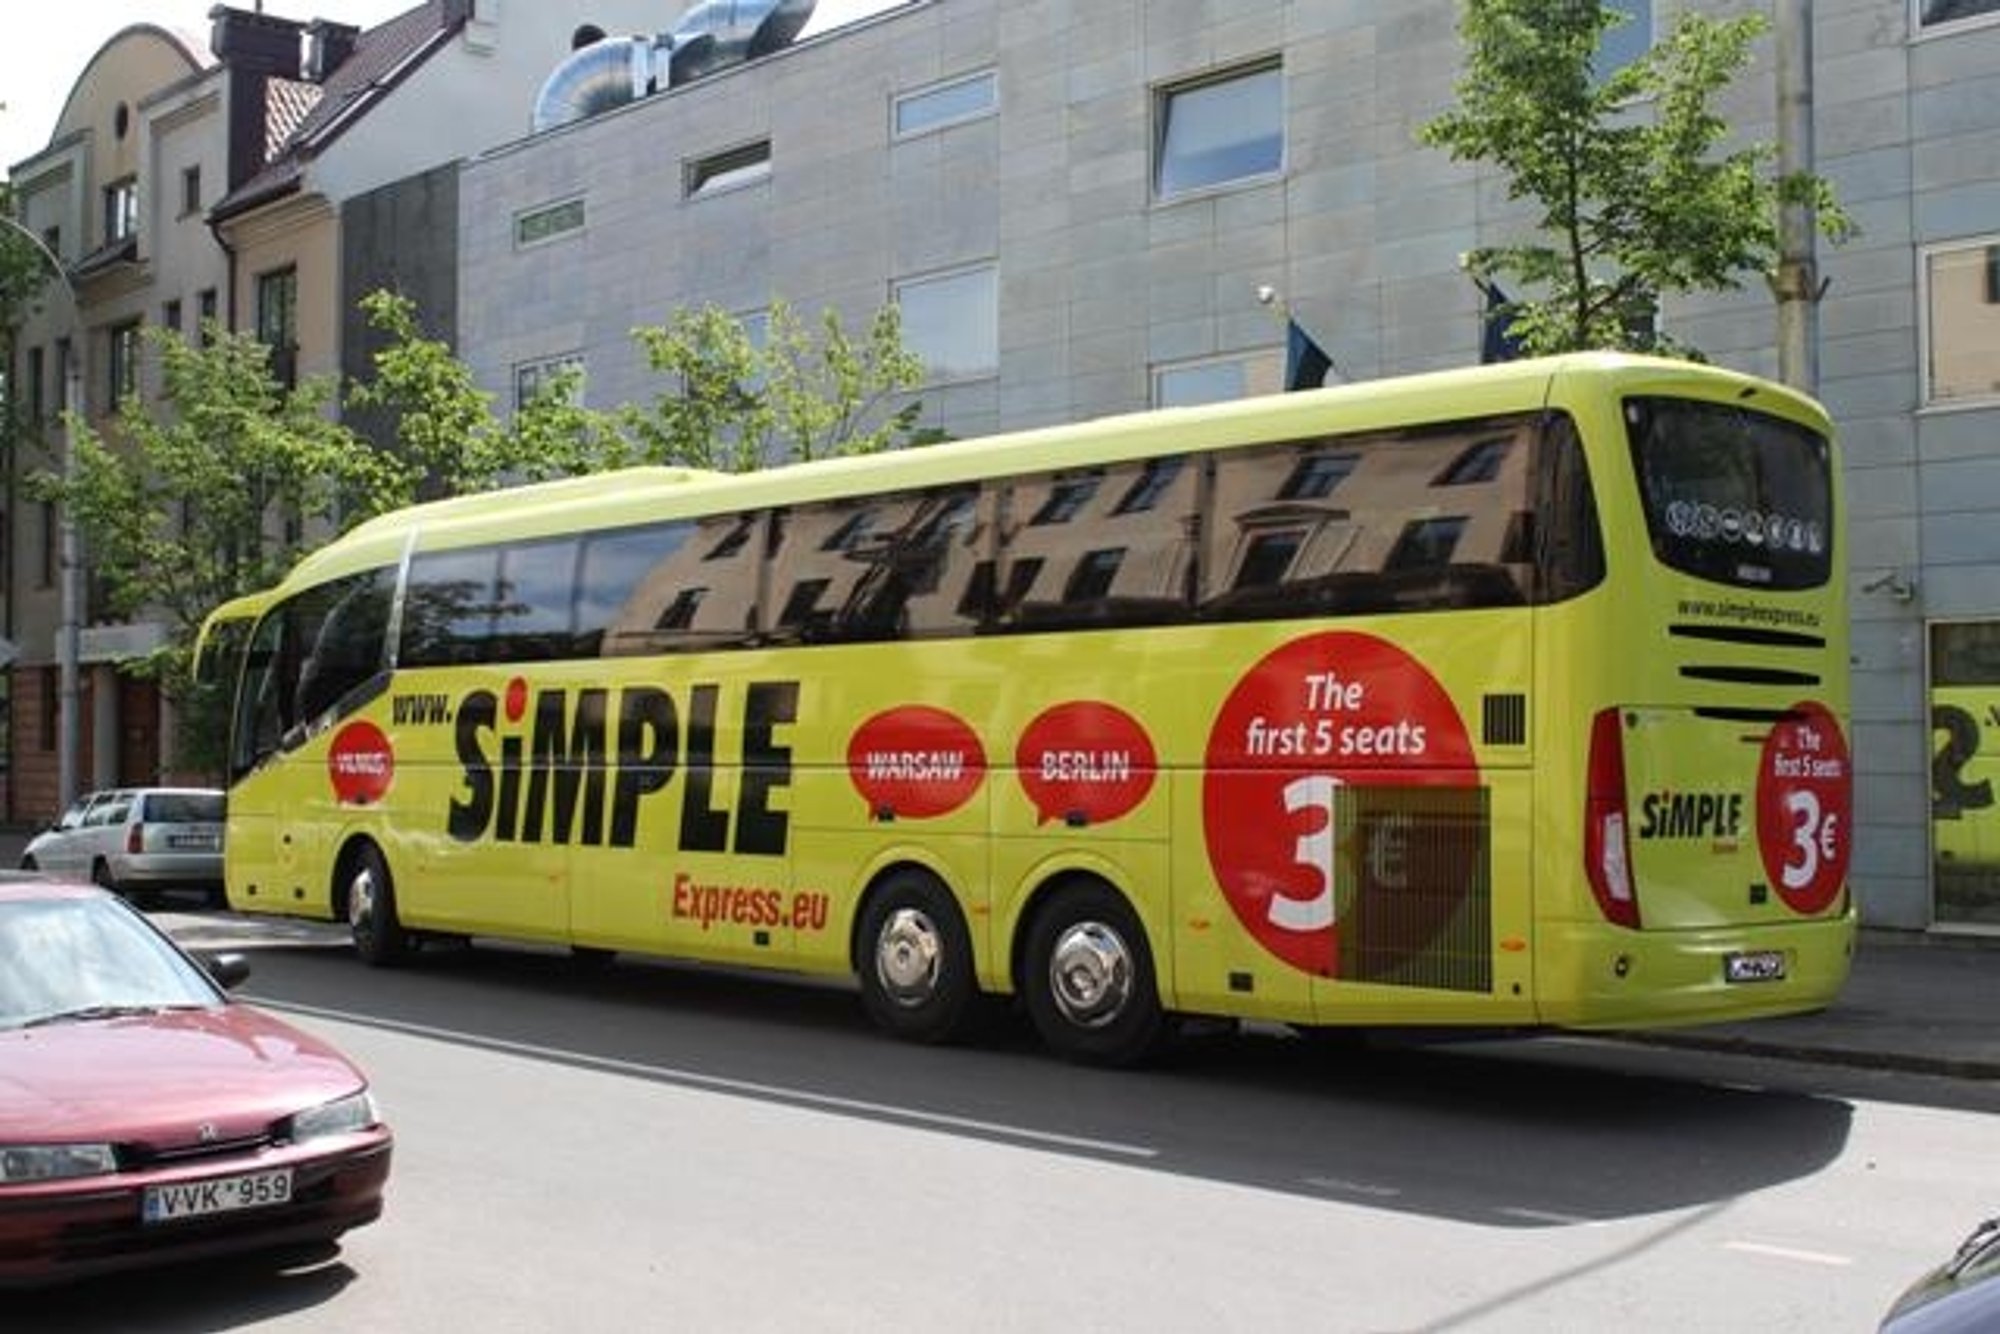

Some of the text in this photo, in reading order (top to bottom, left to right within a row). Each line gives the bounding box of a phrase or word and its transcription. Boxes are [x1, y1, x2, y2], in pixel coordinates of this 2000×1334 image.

[1305, 671, 1363, 711] The
[393, 694, 451, 725] www.
[1247, 717, 1427, 755] first 5 seats
[1797, 726, 1820, 751] The
[867, 750, 964, 780] WARSAW
[1041, 750, 1129, 782] BERLIN
[1803, 755, 1812, 777] 5
[674, 872, 829, 931] Express.eu
